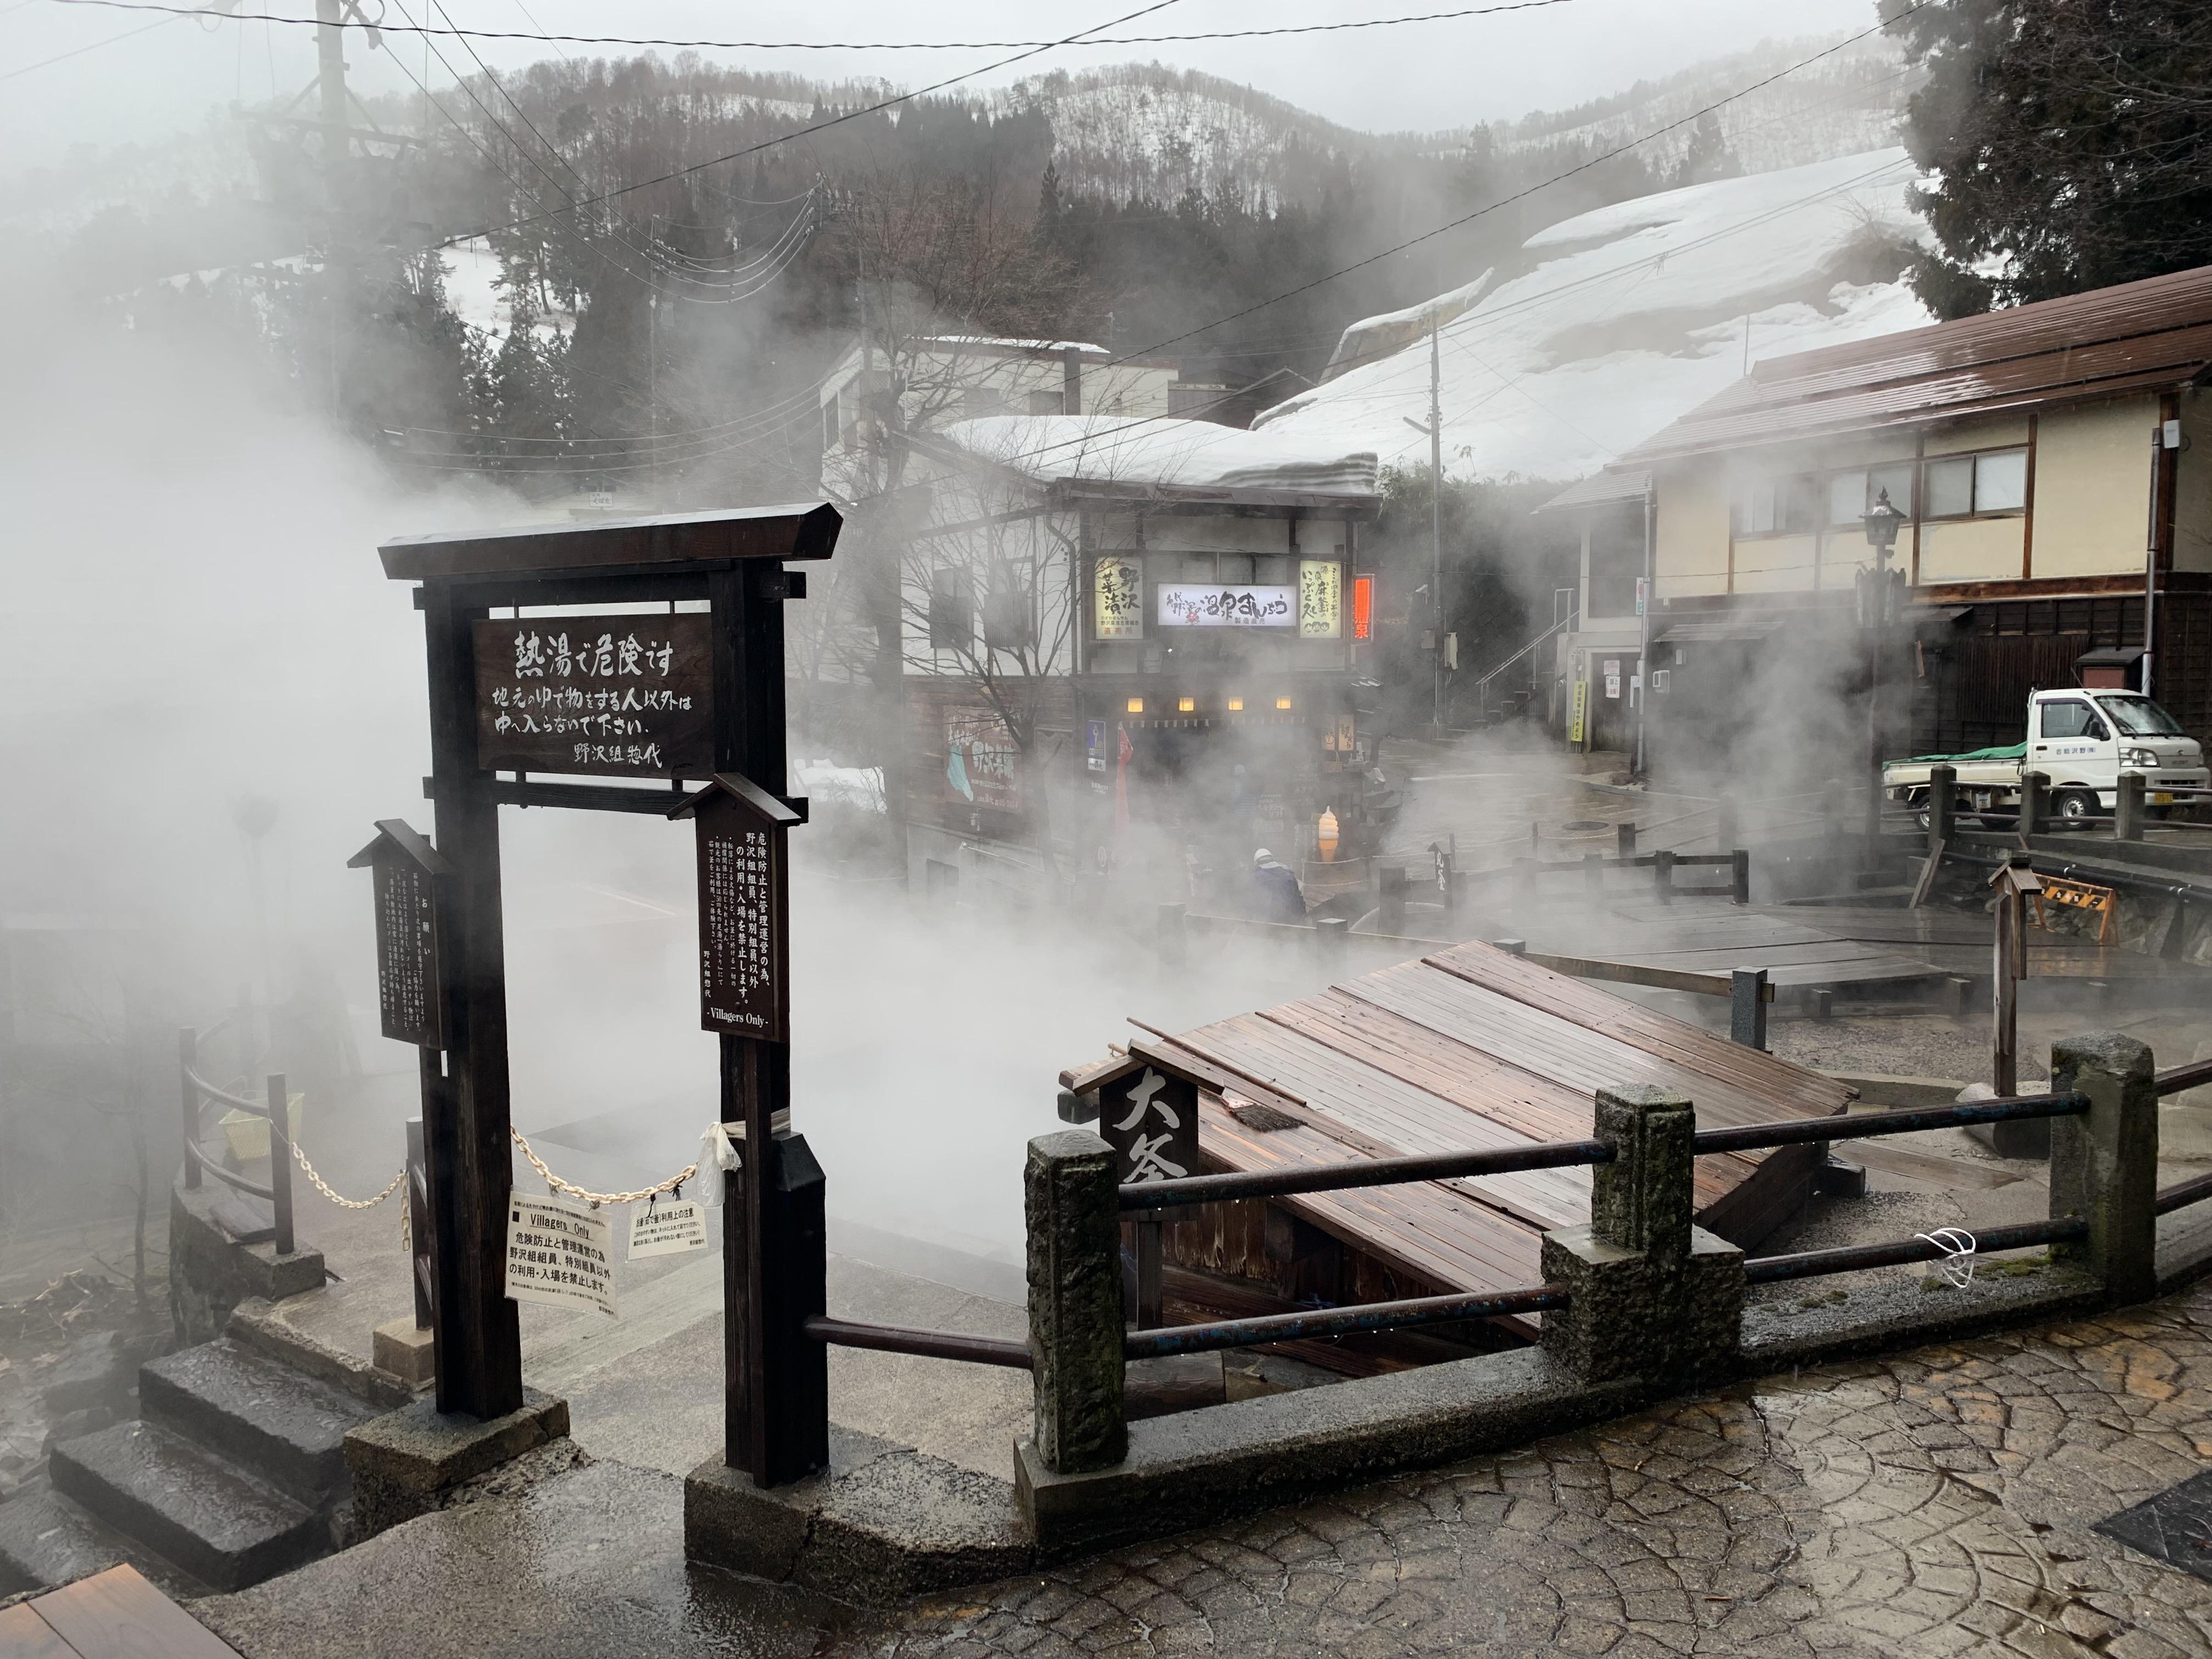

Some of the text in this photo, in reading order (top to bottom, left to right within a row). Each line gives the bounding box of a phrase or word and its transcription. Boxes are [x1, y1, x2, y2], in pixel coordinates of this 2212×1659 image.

[514, 630, 673, 679] 熱湯で危険です
[421, 898, 431, 955] お願い
[736, 845, 749, 1004] の利用・入場を禁止します。
[746, 832, 759, 989] 野沢組組員、特別組員以外
[757, 832, 770, 986] 危険防止と管理運営の為、
[703, 950, 712, 998] 野沢組惣代
[530, 1213, 590, 1239] Villagers Only
[509, 1263, 608, 1295] の利用・入場を禁止します。
[510, 1246, 611, 1280] 野沢組組員、特別組員以外
